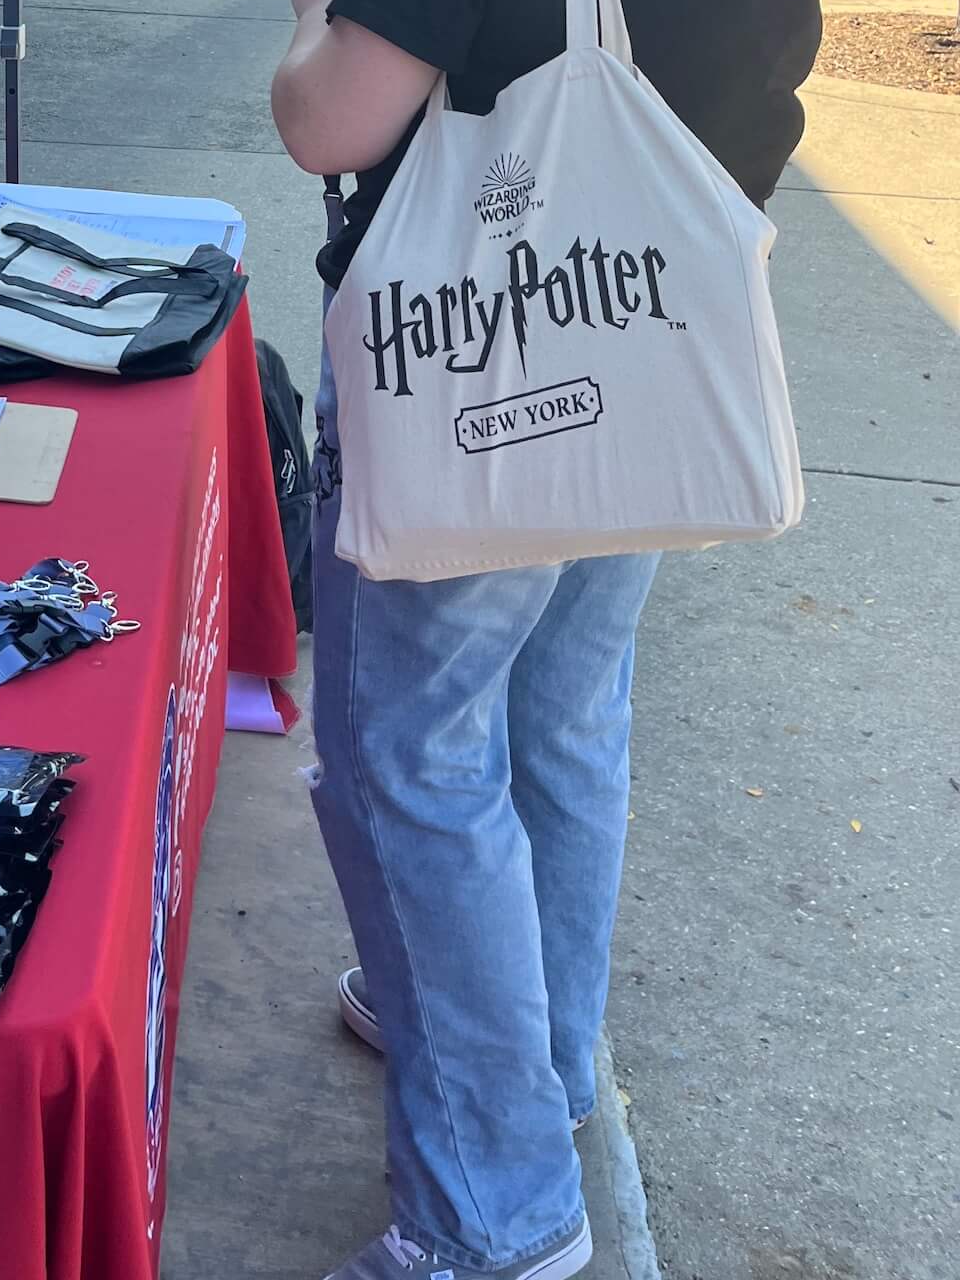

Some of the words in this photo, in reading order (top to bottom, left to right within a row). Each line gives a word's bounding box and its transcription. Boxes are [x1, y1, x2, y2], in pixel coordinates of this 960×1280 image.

[474, 176, 536, 211] WIZARDING
[480, 195, 530, 224] WORLD
[363, 275, 505, 396] Harry
[506, 235, 670, 380] Potter
[470, 410, 518, 440] NEW
[524, 392, 591, 425] YORK
